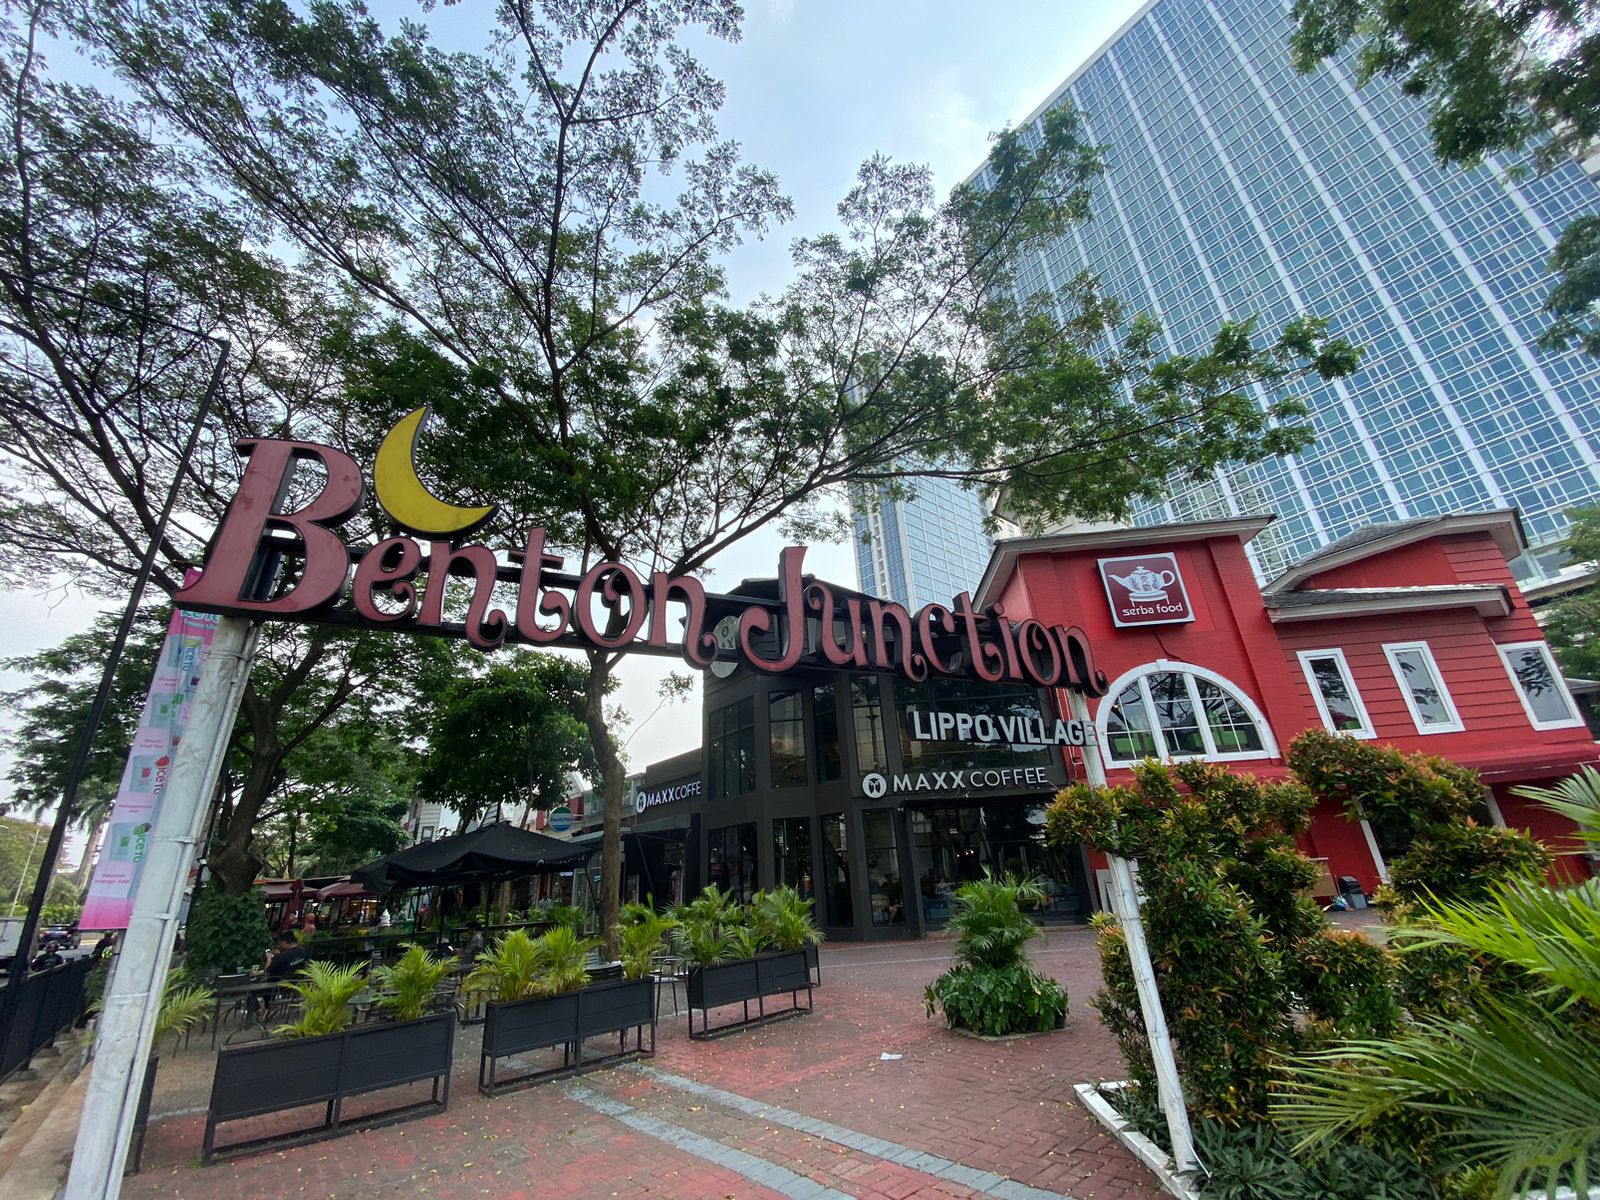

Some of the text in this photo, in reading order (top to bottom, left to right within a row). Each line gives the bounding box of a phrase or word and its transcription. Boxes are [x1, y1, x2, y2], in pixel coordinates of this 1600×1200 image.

[174, 437, 1109, 699] Benton Junction
[1122, 602, 1184, 616] serba food
[913, 711, 1099, 746] LIPPO VILLAGE
[893, 767, 1049, 792] MAXX COFFEE
[647, 781, 702, 807] MAXX COFFE
